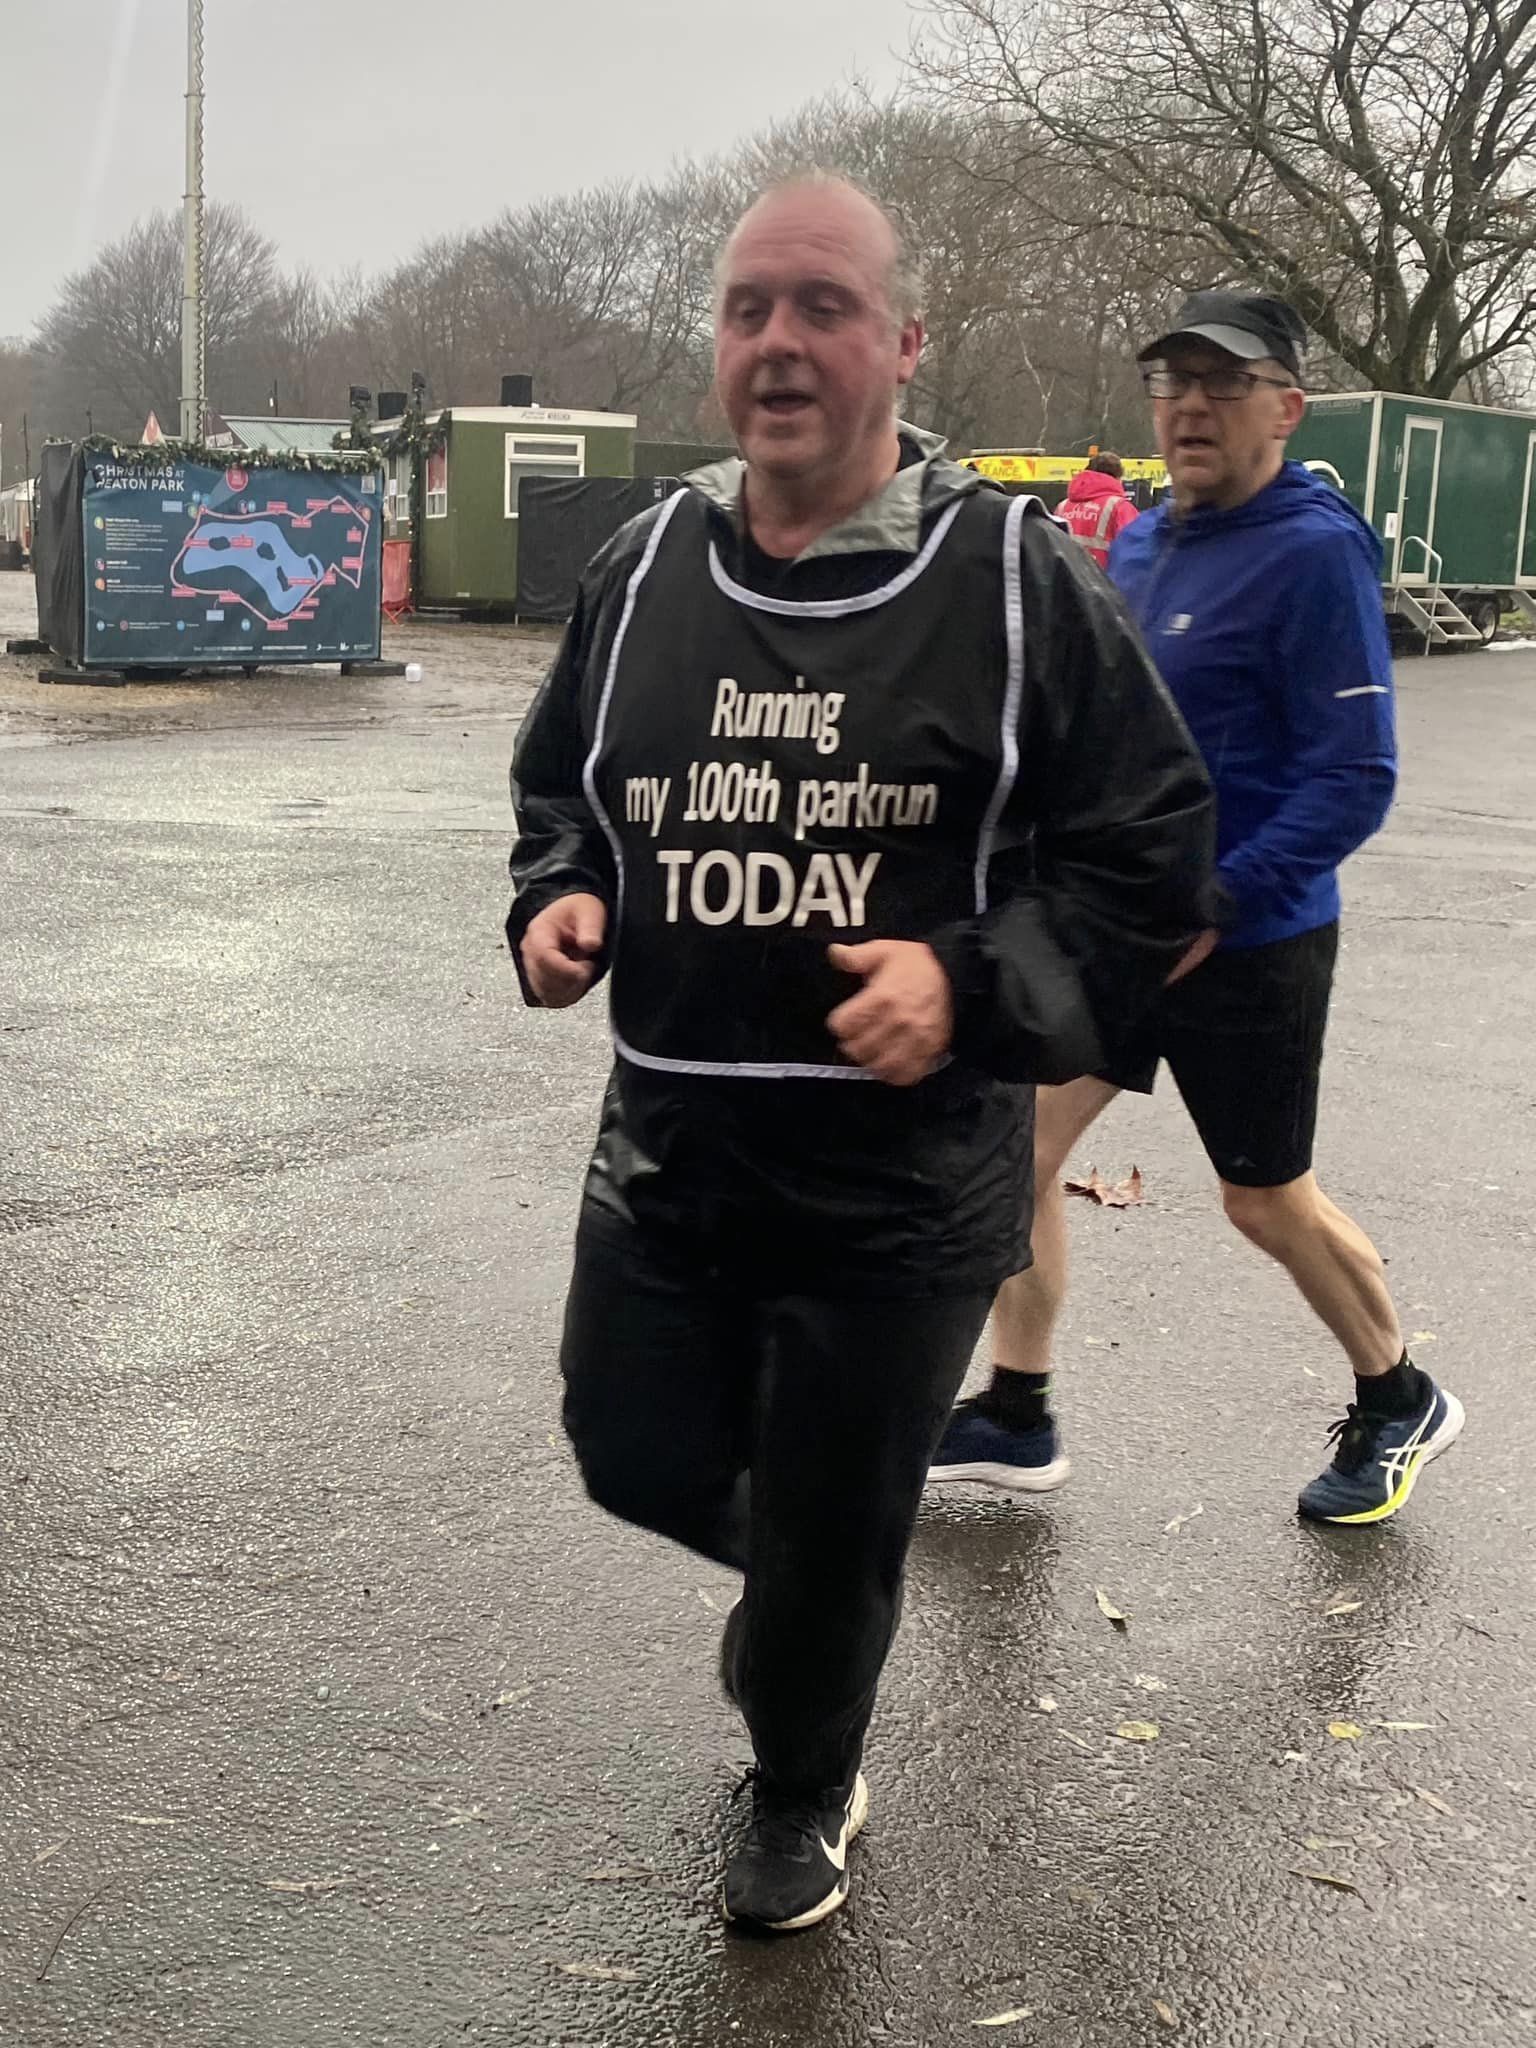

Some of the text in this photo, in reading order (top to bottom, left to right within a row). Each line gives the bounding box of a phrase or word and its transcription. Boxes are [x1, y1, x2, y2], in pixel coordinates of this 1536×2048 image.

[95, 464, 186, 478] CHRISTMAS AT
[151, 479, 185, 491] PARK
[710, 675, 846, 755] Running
[625, 760, 939, 841] my 100th parkrun
[657, 850, 883, 928] TODAY
